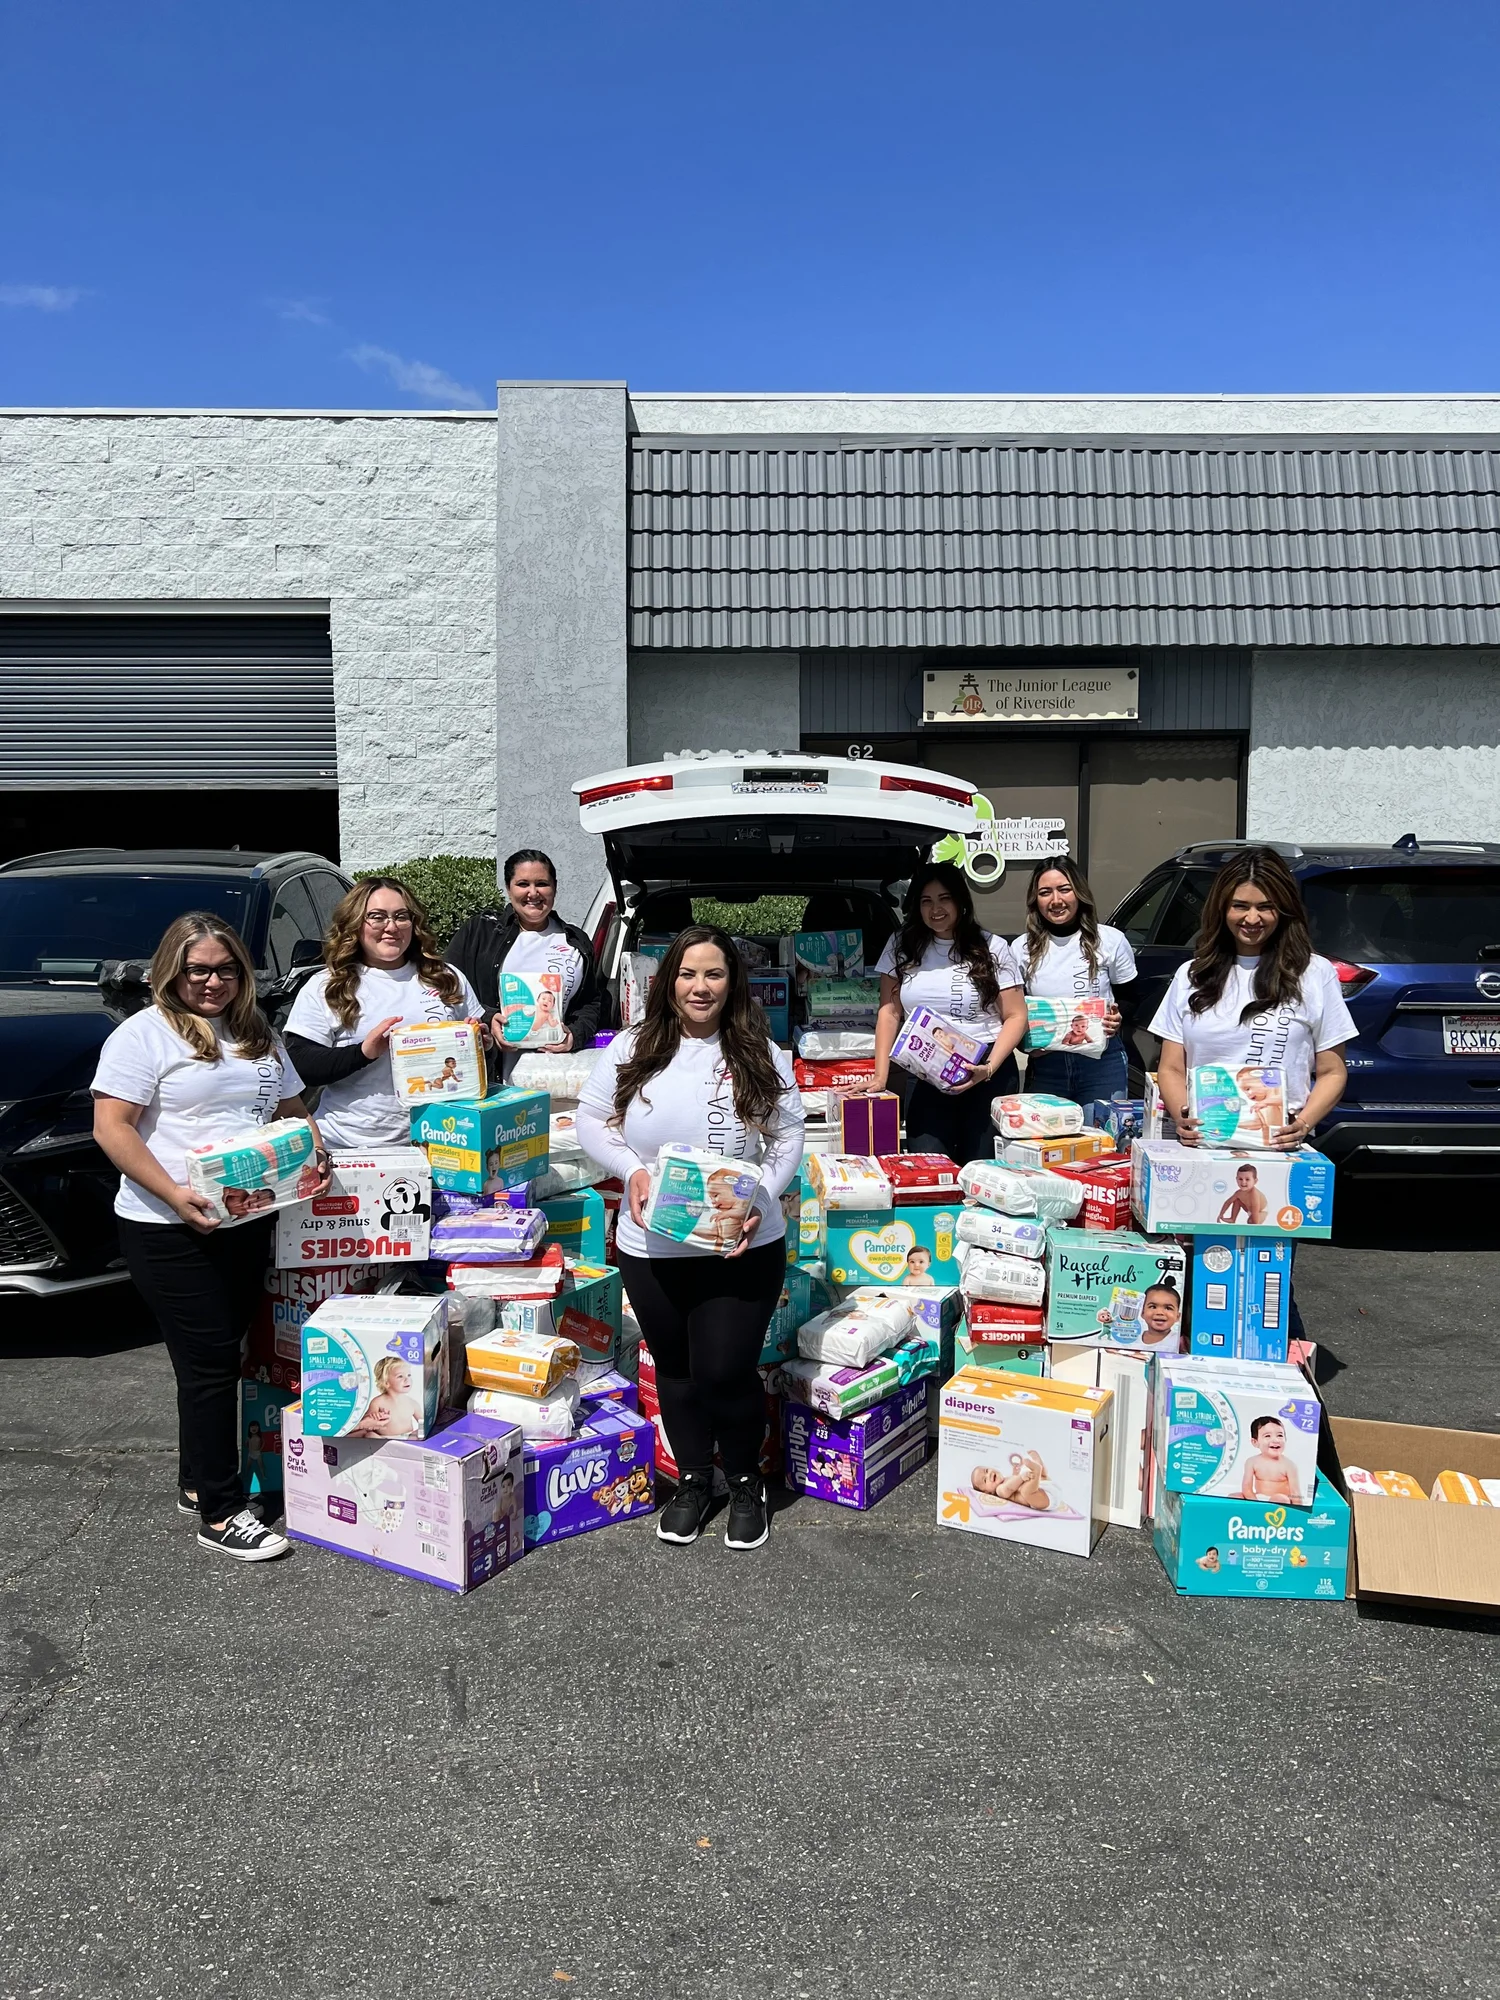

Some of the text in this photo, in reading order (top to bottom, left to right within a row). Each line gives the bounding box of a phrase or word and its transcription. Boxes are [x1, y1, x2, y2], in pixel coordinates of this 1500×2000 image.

[987, 677, 1112, 695] The Junior League
[995, 696, 1076, 710] of Riverside
[847, 744, 873, 758] G2
[988, 820, 1021, 829] Junior
[1024, 819, 1064, 830] League
[983, 830, 1046, 840] of Riverside
[401, 1036, 432, 1045] diapers
[1268, 1070, 1274, 1078] 3
[420, 1120, 468, 1147] Pampers
[495, 1121, 537, 1145] Pampers
[1153, 1164, 1182, 1176] tippy
[1156, 1174, 1179, 1183] toes
[741, 1179, 748, 1189] 3
[1280, 1209, 1294, 1225] 4
[300, 1217, 370, 1231] snug & dry
[991, 1225, 1002, 1234] 34
[1023, 1225, 1032, 1236] 3
[301, 1235, 411, 1260] HUGGIES
[864, 1239, 906, 1254] Pampers
[1059, 1253, 1110, 1272] Rascal
[1157, 1260, 1164, 1268] 6
[835, 1269, 842, 1278] 2
[1057, 1292, 1097, 1302] PREMIUM DIAPERS
[525, 1308, 532, 1318] 3
[930, 1305, 937, 1313] 3
[927, 1316, 940, 1325] 100
[977, 1315, 983, 1323] 2
[981, 1332, 1026, 1341] HUGGIES
[407, 1350, 420, 1359] 60
[1020, 1350, 1027, 1359] 3
[309, 1356, 347, 1365] SMALL STRIDES
[472, 1406, 497, 1415] diapers
[944, 1396, 996, 1415] diapers
[1303, 1403, 1313, 1415] 5
[1176, 1410, 1216, 1421] SMALL STRIDES
[1301, 1418, 1314, 1428] 72
[1077, 1435, 1083, 1445] 1
[571, 1450, 580, 1459] 12
[288, 1455, 300, 1465] Dry
[287, 1462, 308, 1474] Gentle
[549, 1459, 606, 1508] Luvs
[481, 1485, 492, 1495] Dry
[480, 1489, 498, 1502] Gentle
[1227, 1516, 1304, 1544] Pampers
[1242, 1544, 1288, 1557] baby-dry
[1323, 1551, 1331, 1561] 2
[473, 1553, 493, 1574] Size 3
